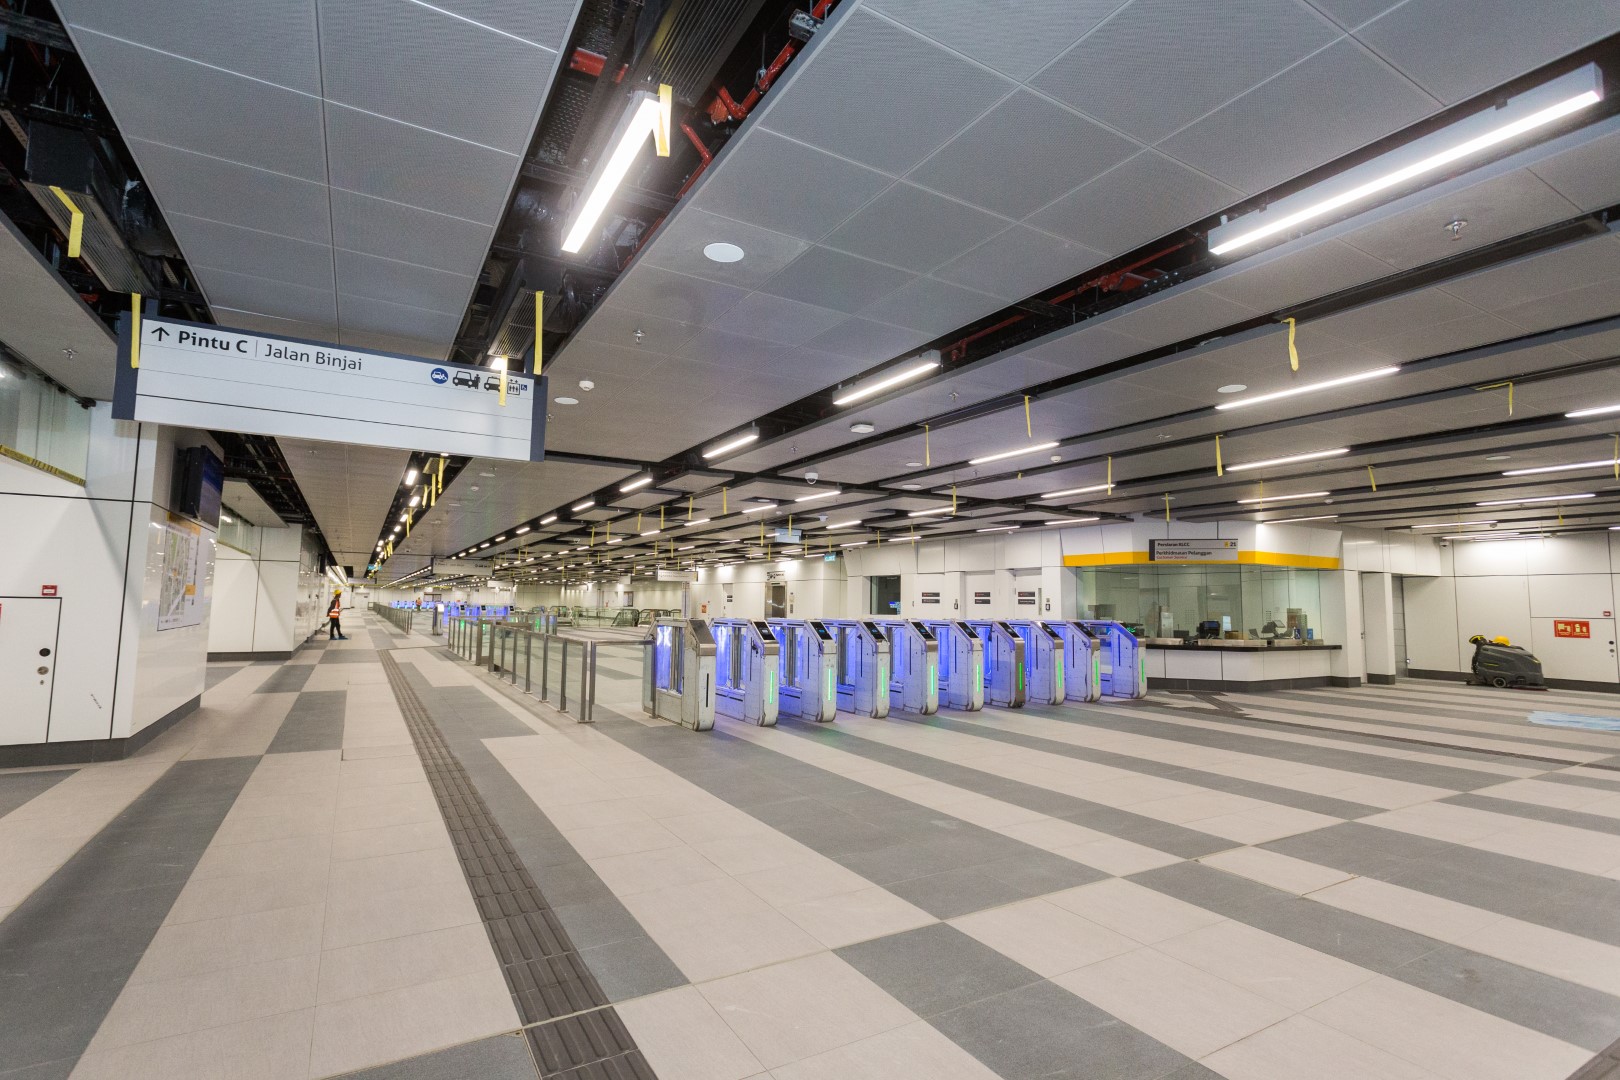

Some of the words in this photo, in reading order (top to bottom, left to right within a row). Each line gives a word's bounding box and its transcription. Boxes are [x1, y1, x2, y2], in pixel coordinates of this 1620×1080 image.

[178, 331, 230, 351] Pintu
[236, 340, 248, 353] C
[265, 344, 310, 363] Jalan
[315, 351, 362, 371] Binjai
